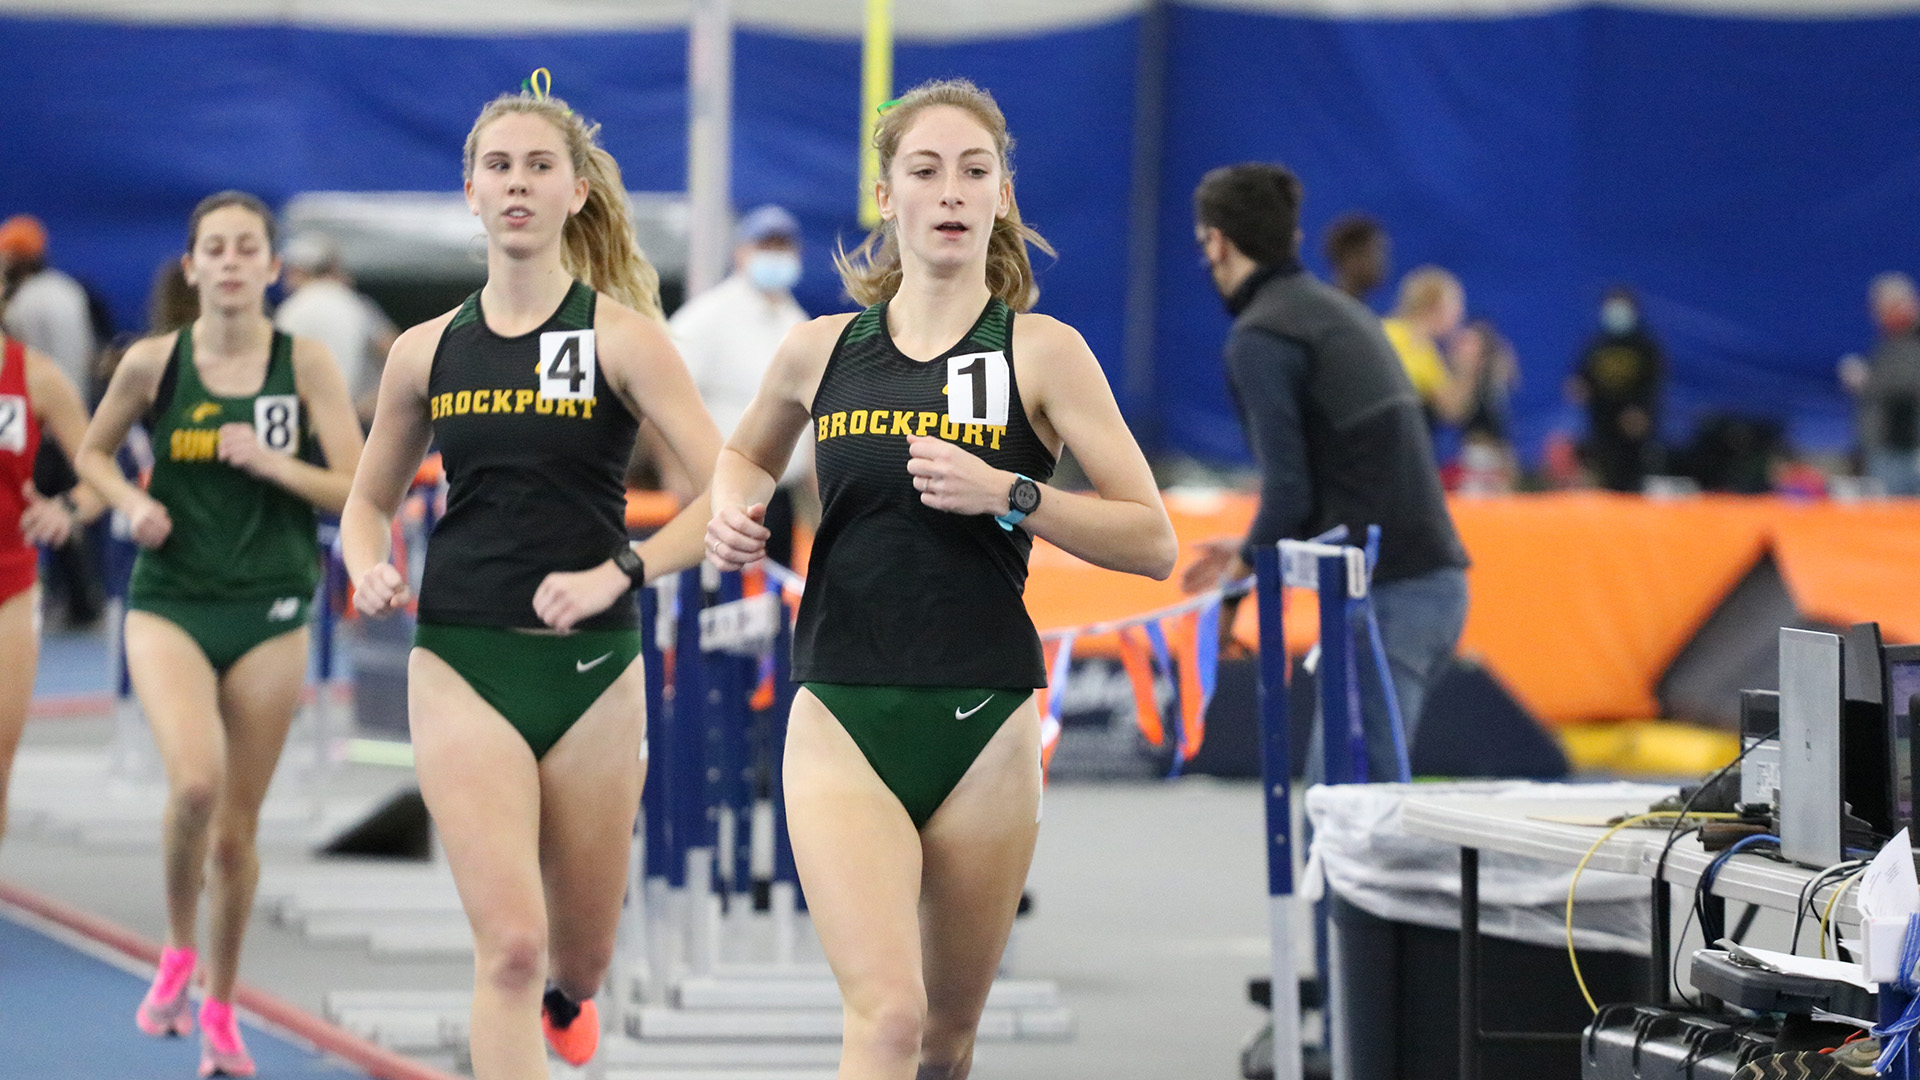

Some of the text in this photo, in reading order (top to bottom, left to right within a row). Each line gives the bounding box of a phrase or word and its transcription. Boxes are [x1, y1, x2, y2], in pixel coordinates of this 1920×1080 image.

[547, 336, 586, 392] 4
[431, 389, 597, 420] BROCKPORT
[957, 357, 987, 419] 1
[266, 402, 289, 449] 8
[818, 410, 1006, 450] BROCKPORT
